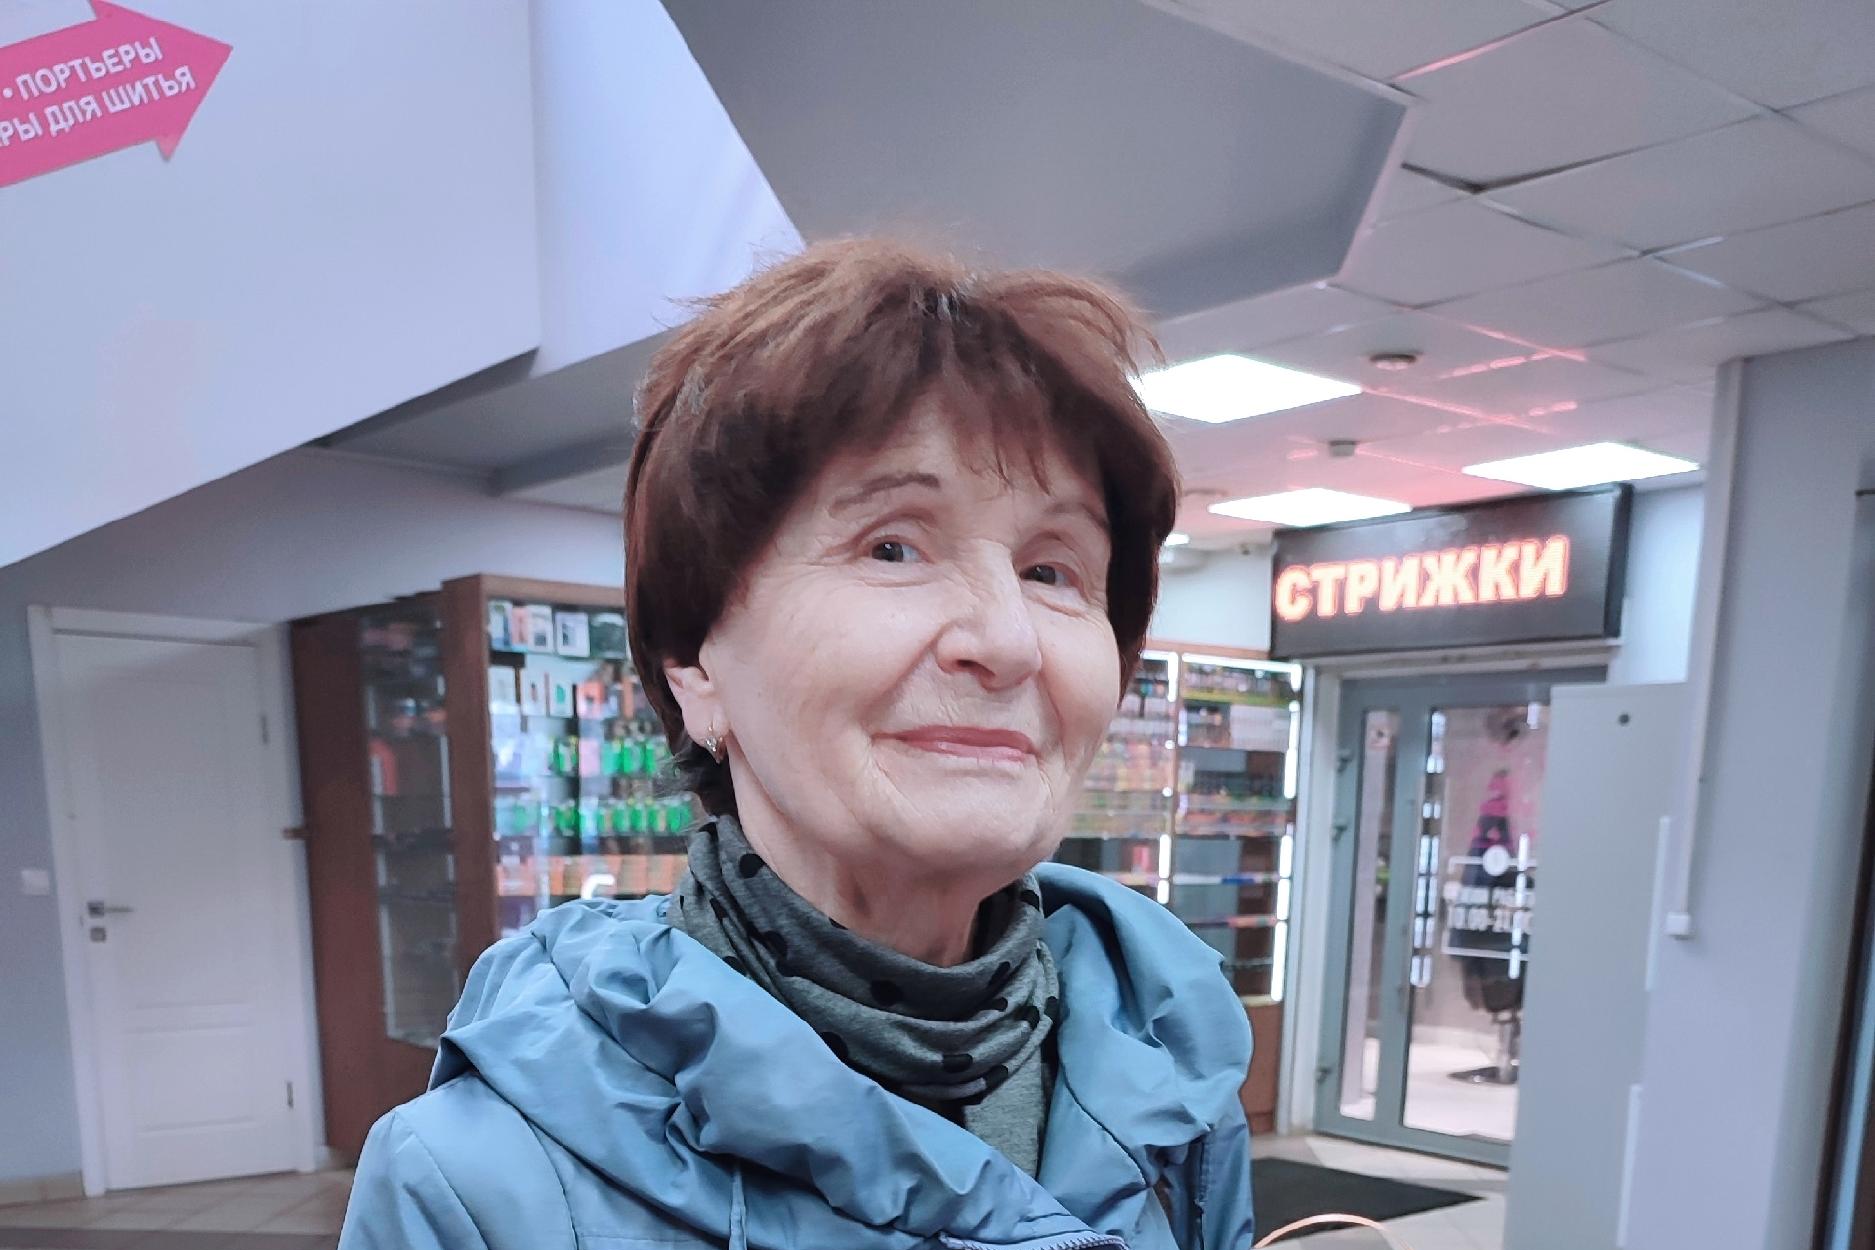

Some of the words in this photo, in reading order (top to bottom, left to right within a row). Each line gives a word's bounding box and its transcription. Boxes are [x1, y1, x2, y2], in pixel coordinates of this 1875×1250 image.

[0, 112, 43, 147] РЫ
[44, 95, 102, 137] ДЛЯ
[103, 65, 196, 114] ШИТЬЯ
[16, 36, 163, 100] ПОРТЬЕРЫ
[1275, 534, 1570, 621] СТРИЖКИ
